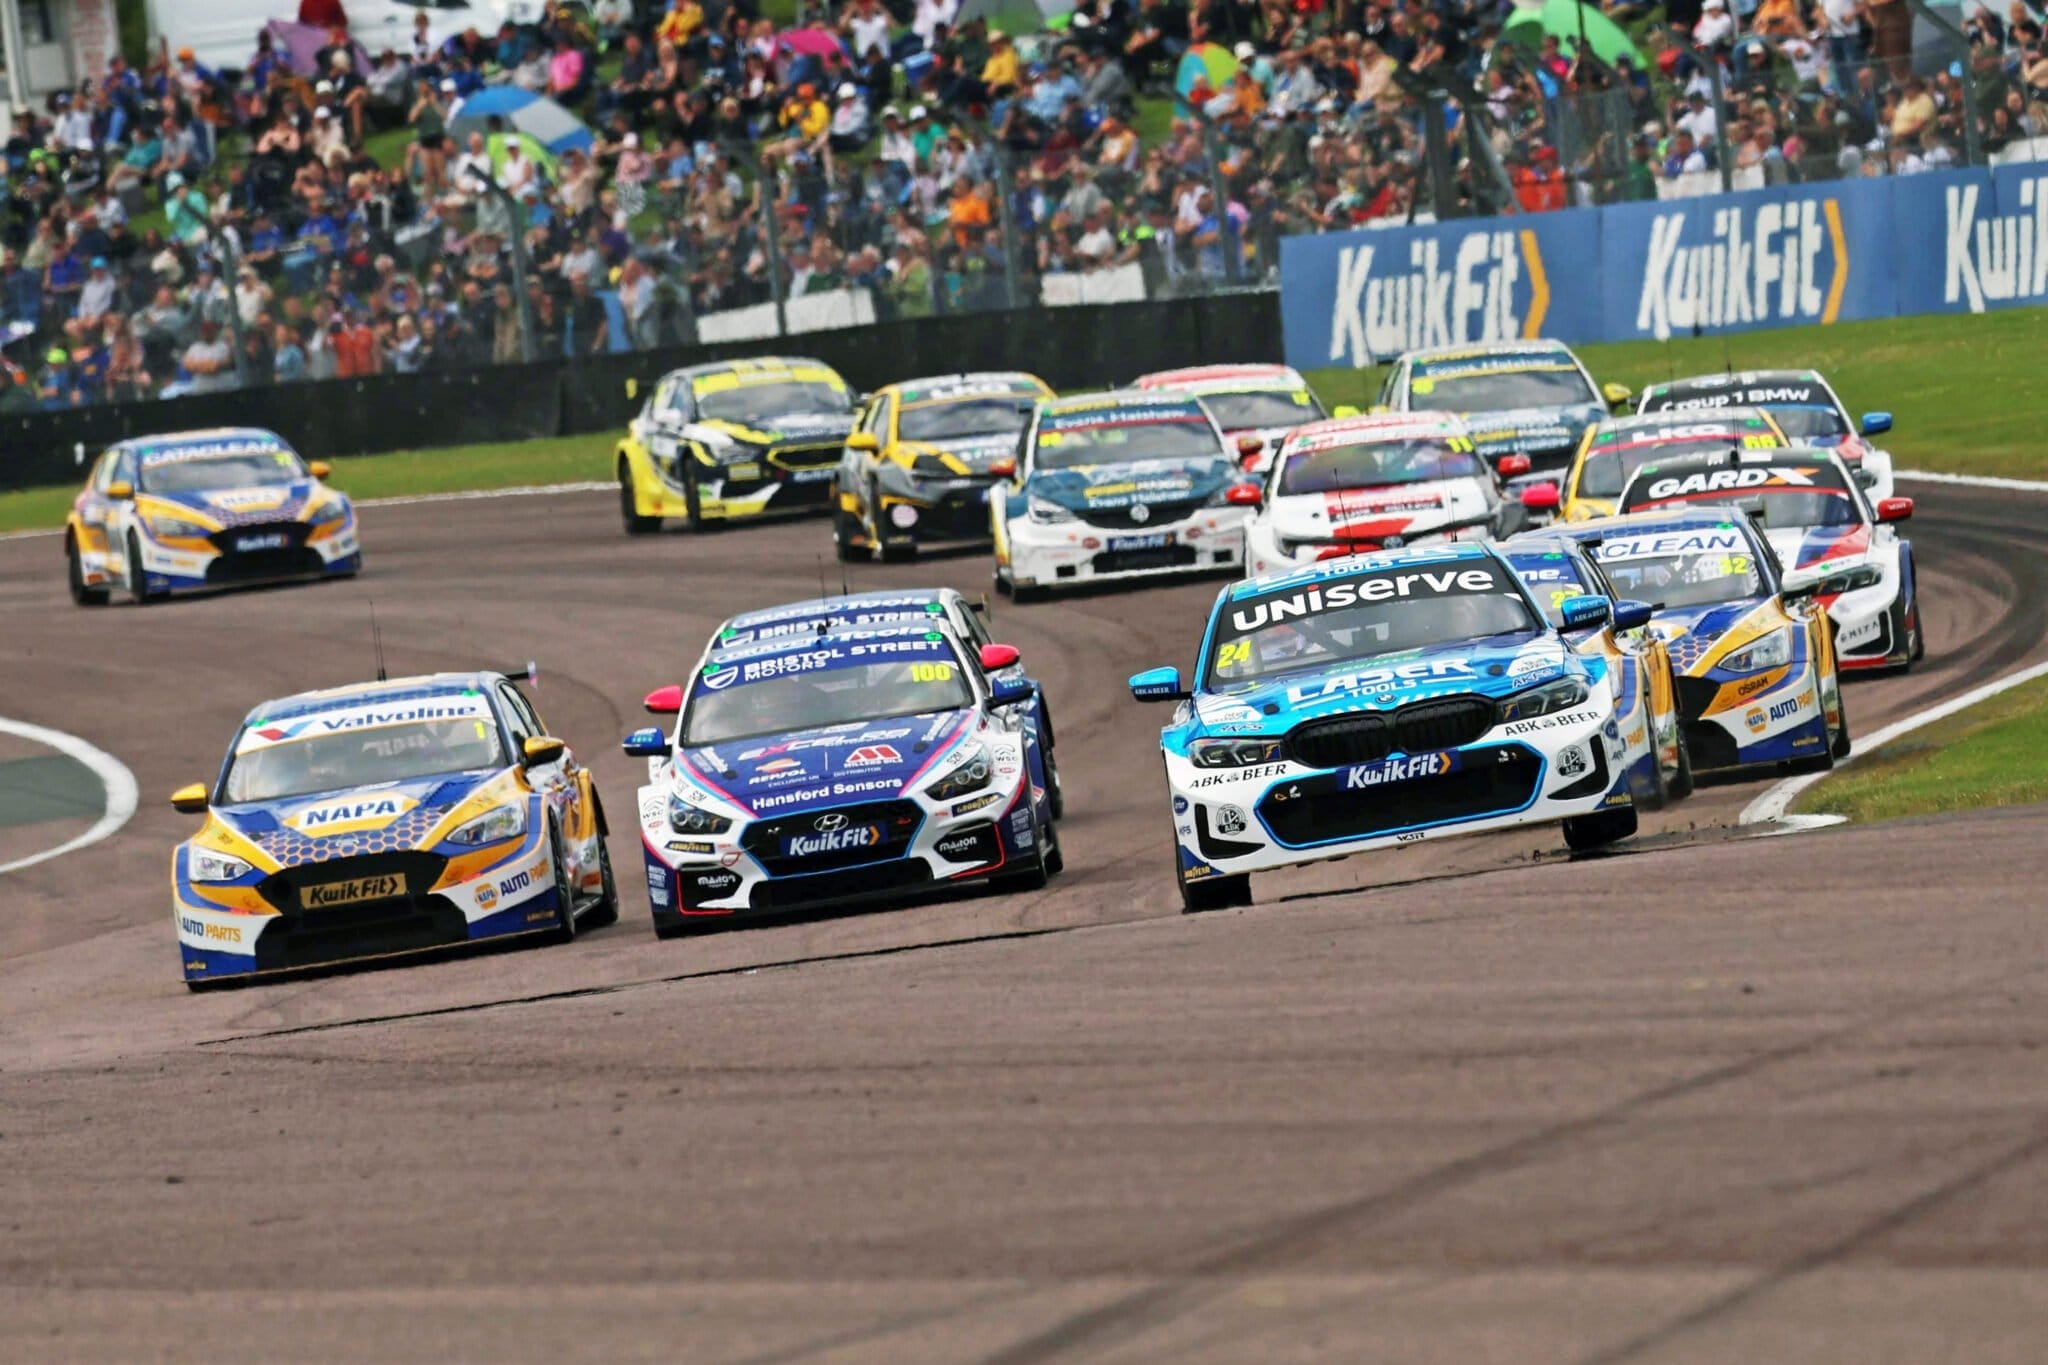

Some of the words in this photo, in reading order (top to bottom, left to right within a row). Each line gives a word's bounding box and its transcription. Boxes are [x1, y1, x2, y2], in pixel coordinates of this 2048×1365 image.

[1748, 388, 1811, 403] BMW
[1719, 557, 1749, 575] 32
[855, 611, 941, 625] STREET
[744, 649, 844, 674] BRISTOL
[850, 640, 942, 657] STREET
[1216, 640, 1251, 668] 24
[744, 659, 827, 682] MOTORS
[908, 663, 952, 683] 100
[1286, 658, 1476, 704] LASER
[1349, 678, 1418, 699] TOOLS
[1738, 676, 1769, 696] OSRAM
[322, 705, 477, 731] Valvoline
[1769, 698, 1798, 722] AUTO
[473, 721, 486, 739] 1
[1504, 720, 1541, 737] ABK
[1556, 711, 1601, 727] BEER
[1189, 773, 1224, 790] ABK
[1242, 763, 1287, 781] BEER
[752, 786, 830, 810] Hansford
[833, 777, 904, 795] Sensors
[306, 801, 397, 826] NAPA
[499, 871, 530, 897] AUTO
[182, 918, 205, 937] AUTO
[206, 924, 241, 943] PARTS
